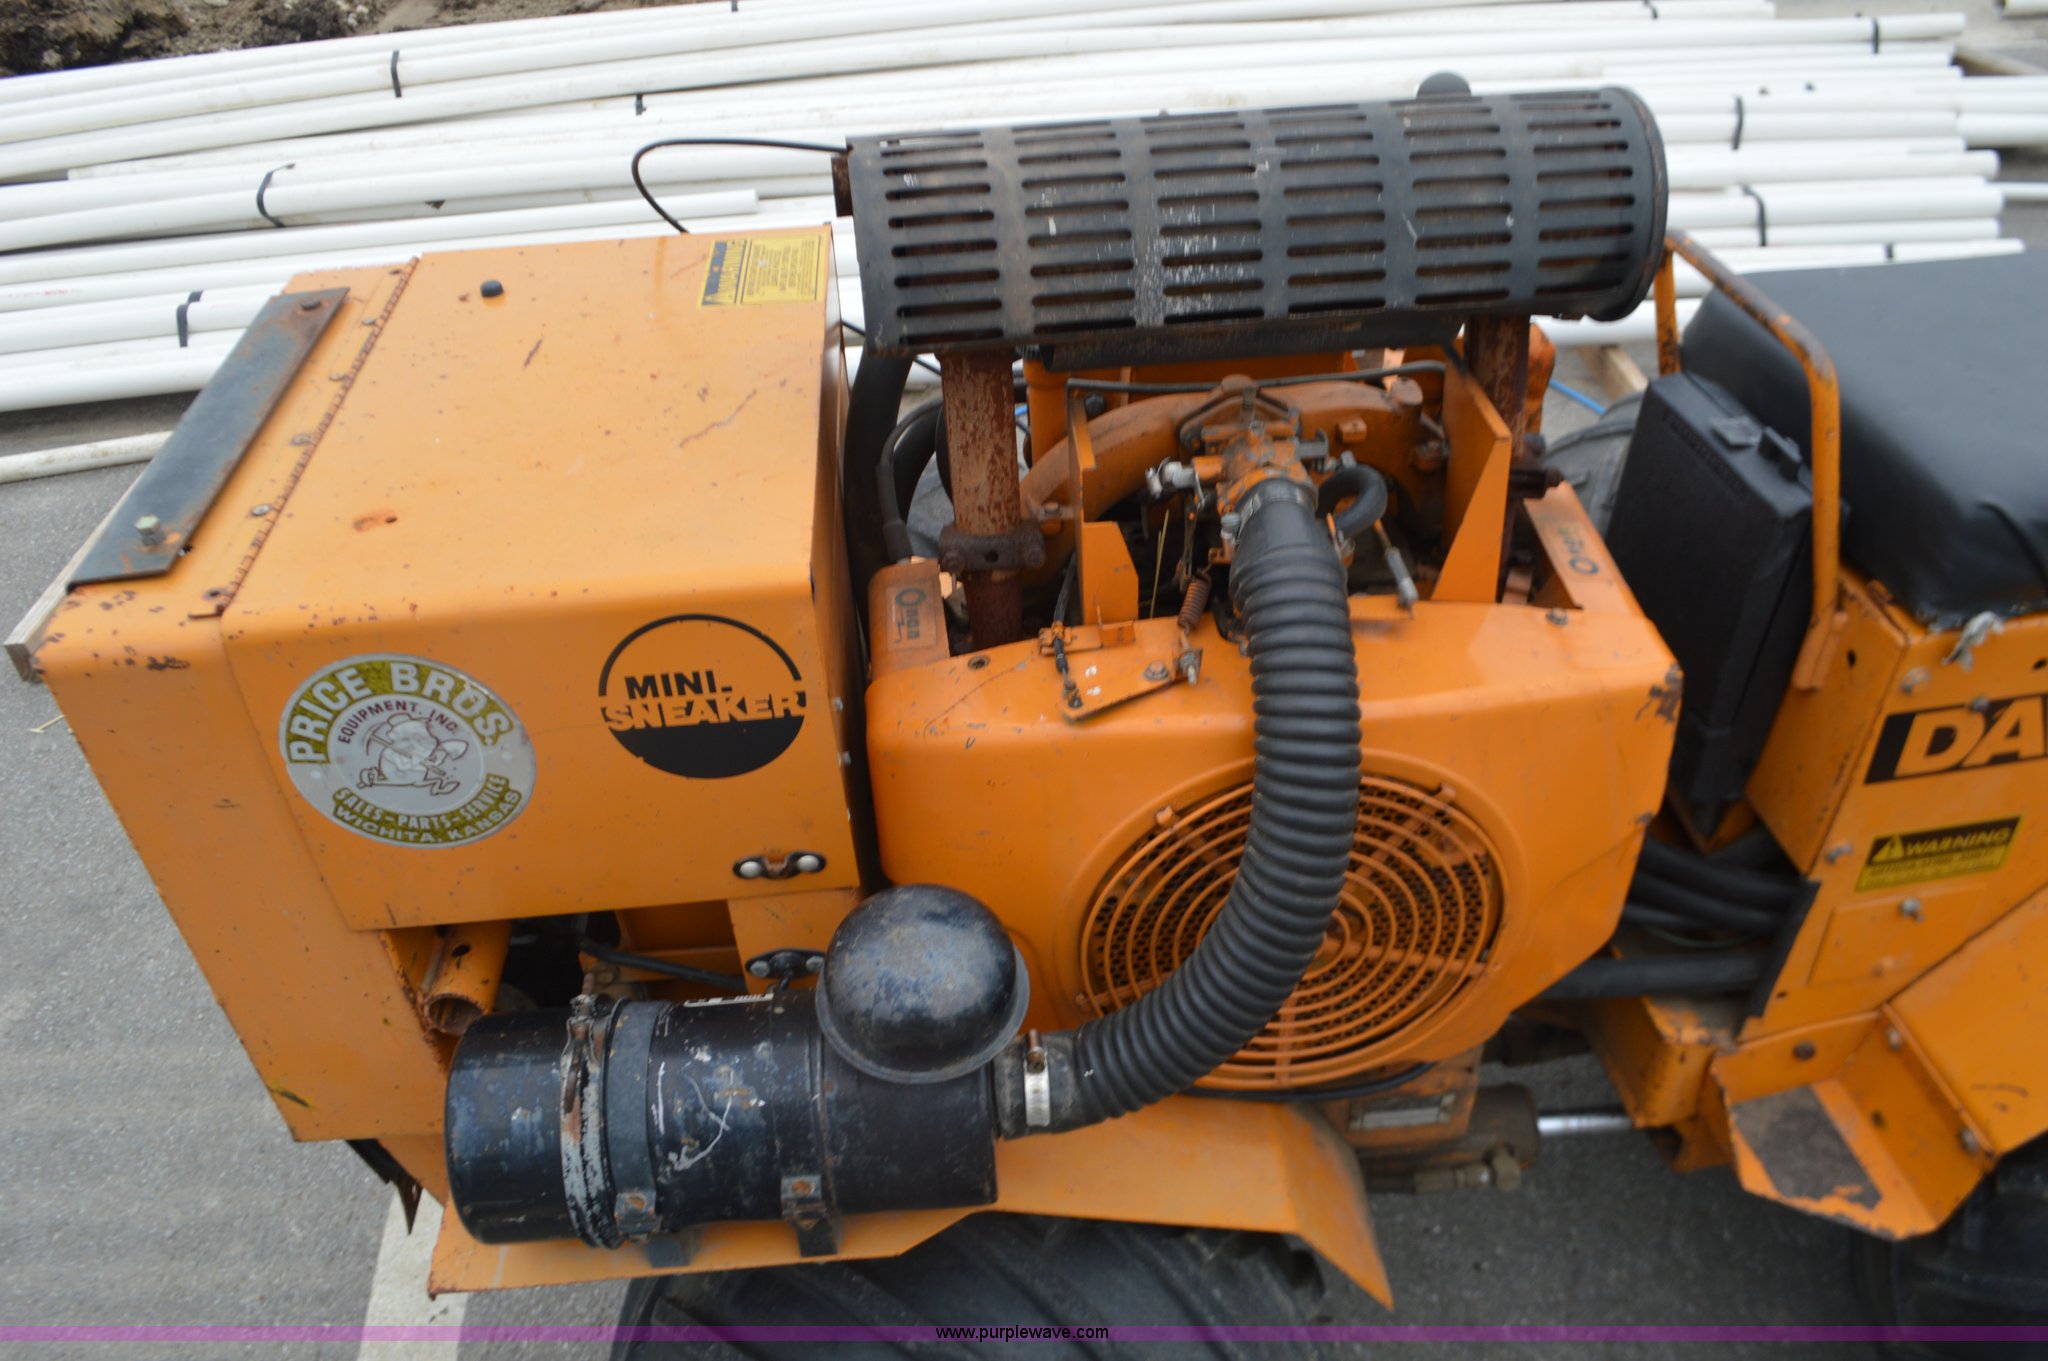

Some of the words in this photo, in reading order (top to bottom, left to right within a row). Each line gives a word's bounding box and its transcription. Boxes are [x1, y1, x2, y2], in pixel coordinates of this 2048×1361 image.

[289, 668, 373, 762] PRICE
[602, 689, 801, 731] SNEAKER
[1892, 694, 2048, 778] DA
[449, 790, 521, 841] KANSAS
[1906, 827, 2011, 855] WARNING
